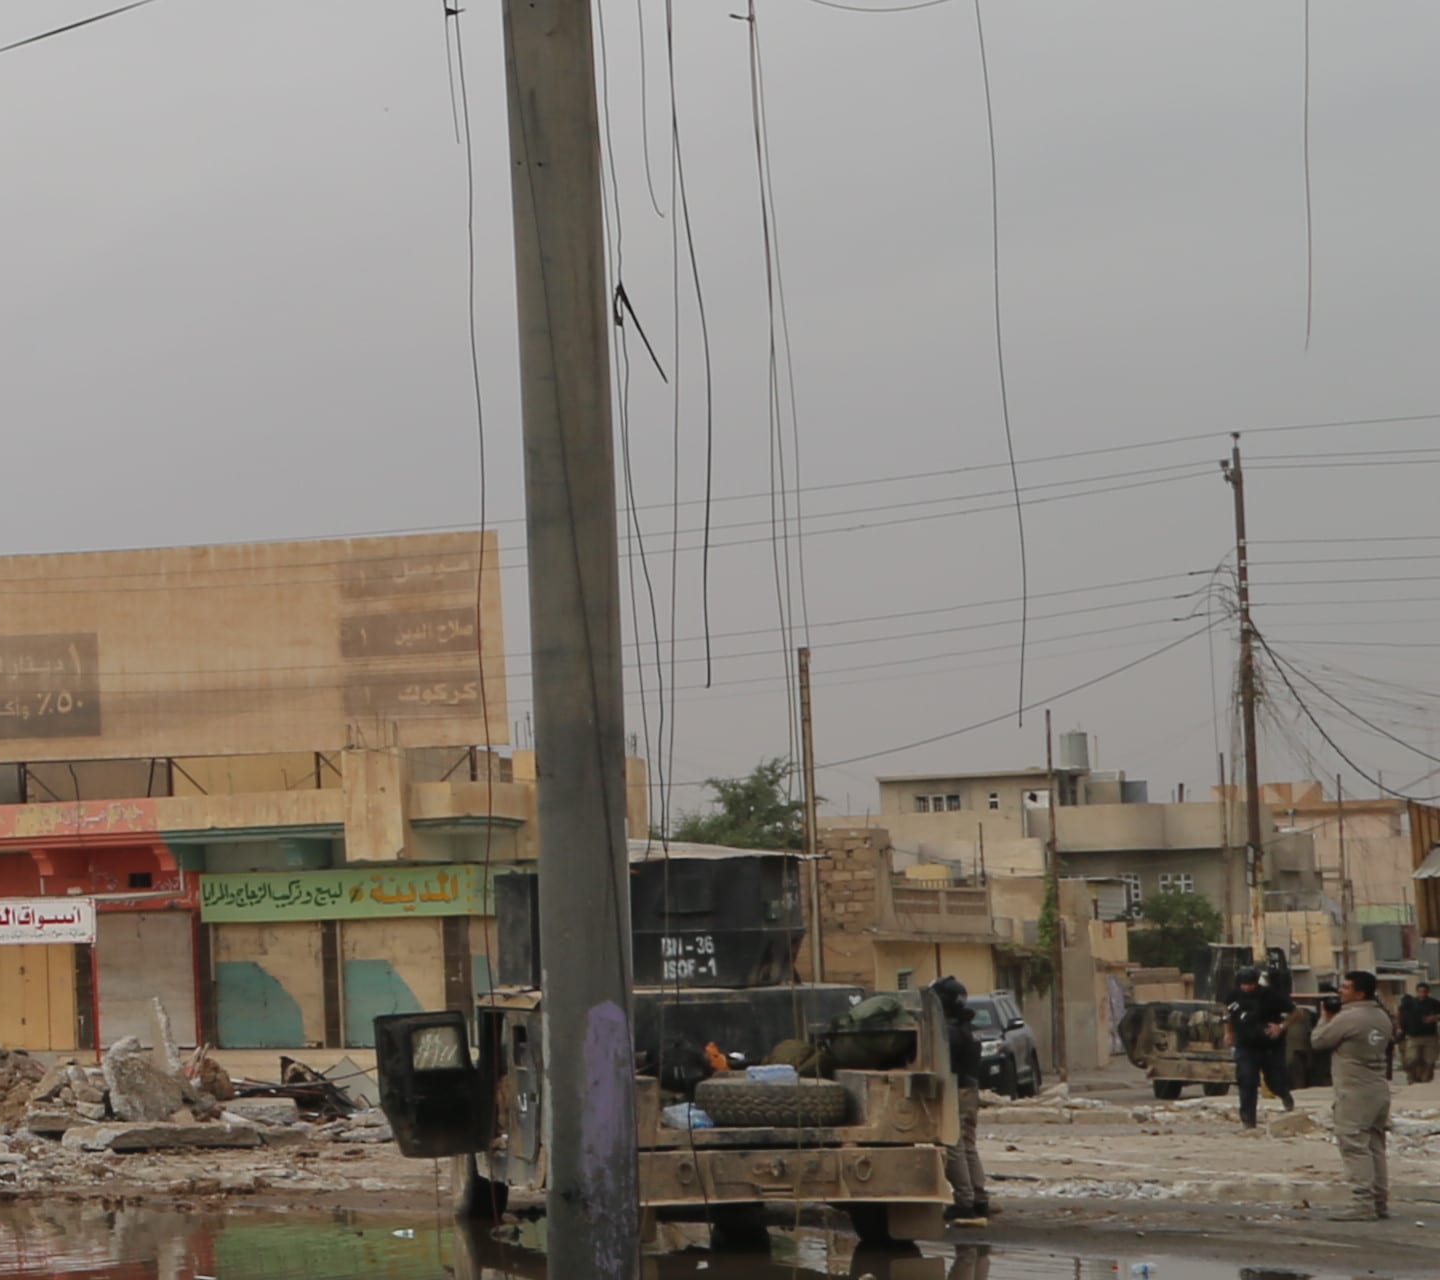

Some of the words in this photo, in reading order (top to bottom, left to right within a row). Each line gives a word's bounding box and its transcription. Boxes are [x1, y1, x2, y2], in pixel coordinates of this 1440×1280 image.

[397, 681, 478, 706] كركوك
[369, 872, 459, 911] المدينة
[663, 957, 717, 979] ISOF-1
